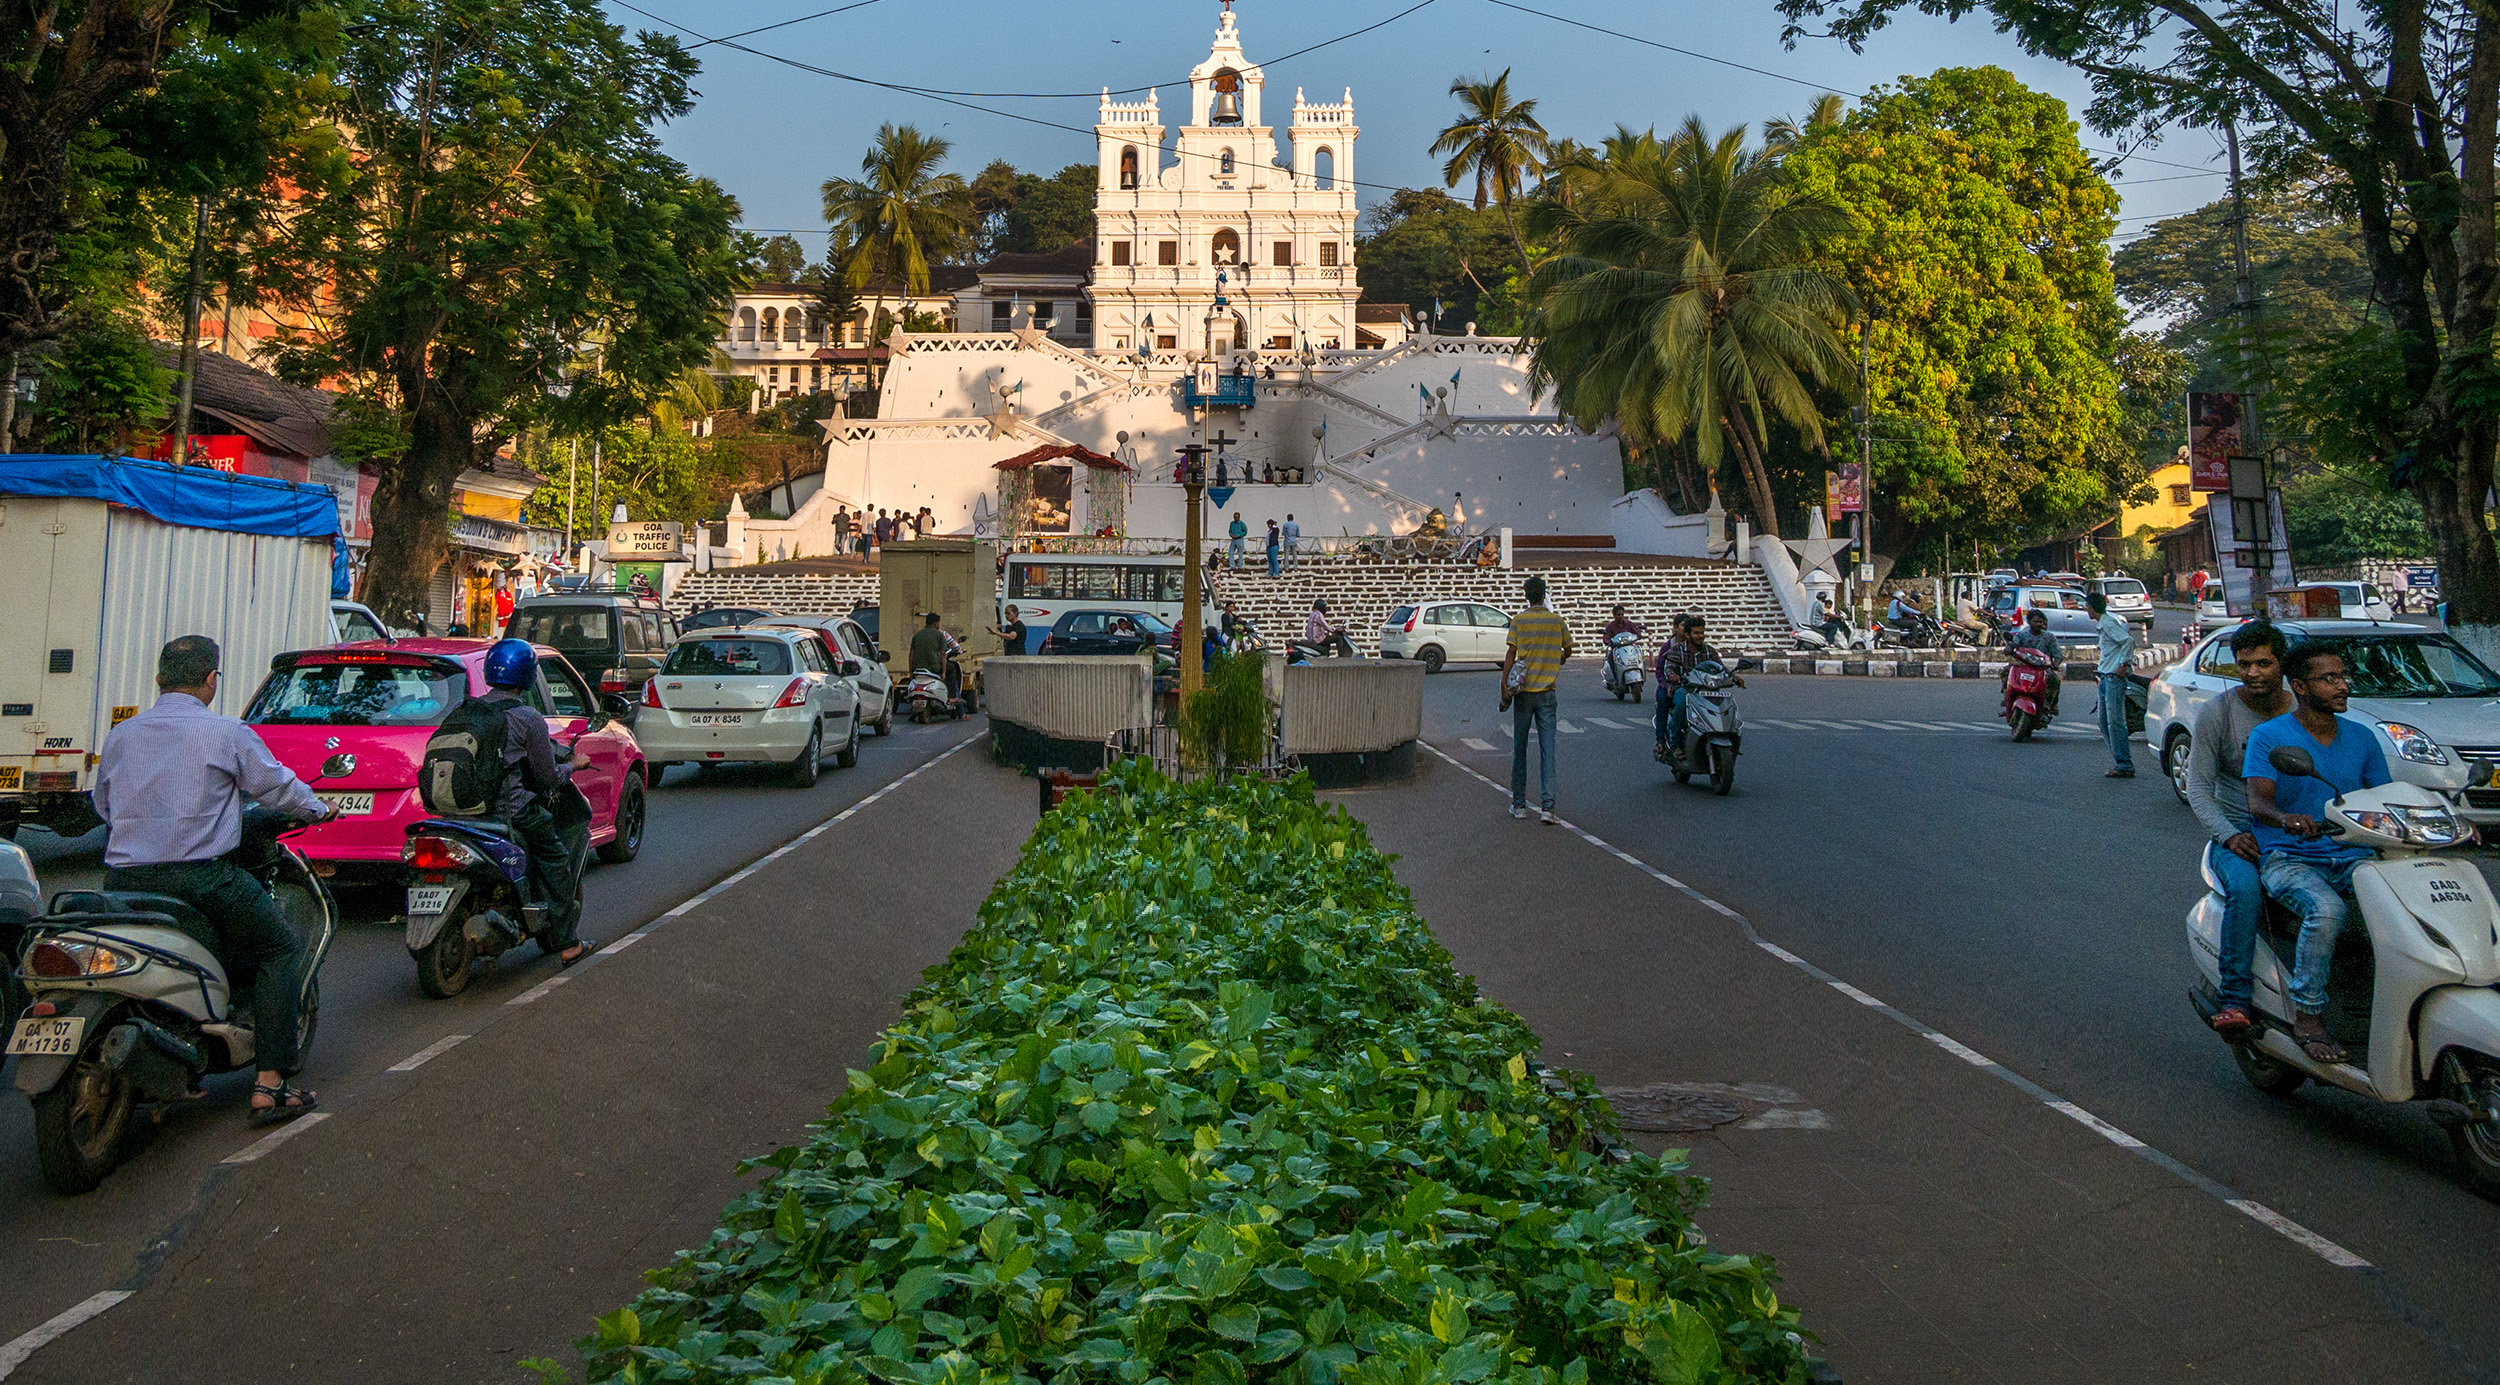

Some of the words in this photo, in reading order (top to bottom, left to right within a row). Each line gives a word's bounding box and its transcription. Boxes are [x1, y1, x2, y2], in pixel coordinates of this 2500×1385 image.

[643, 523, 663, 531] GOA
[633, 532, 671, 541] TRAFFIC
[635, 542, 668, 550] POLICE
[691, 716, 701, 724] GA
[702, 715, 712, 723] 07
[714, 715, 721, 723] K
[722, 715, 741, 723] 8345
[44, 738, 73, 748] HORN
[0, 777, 20, 788] 738
[338, 796, 372, 811] 4944
[2430, 880, 2461, 890] GA03
[417, 891, 440, 899] GA07
[2430, 892, 2472, 903] AA6394
